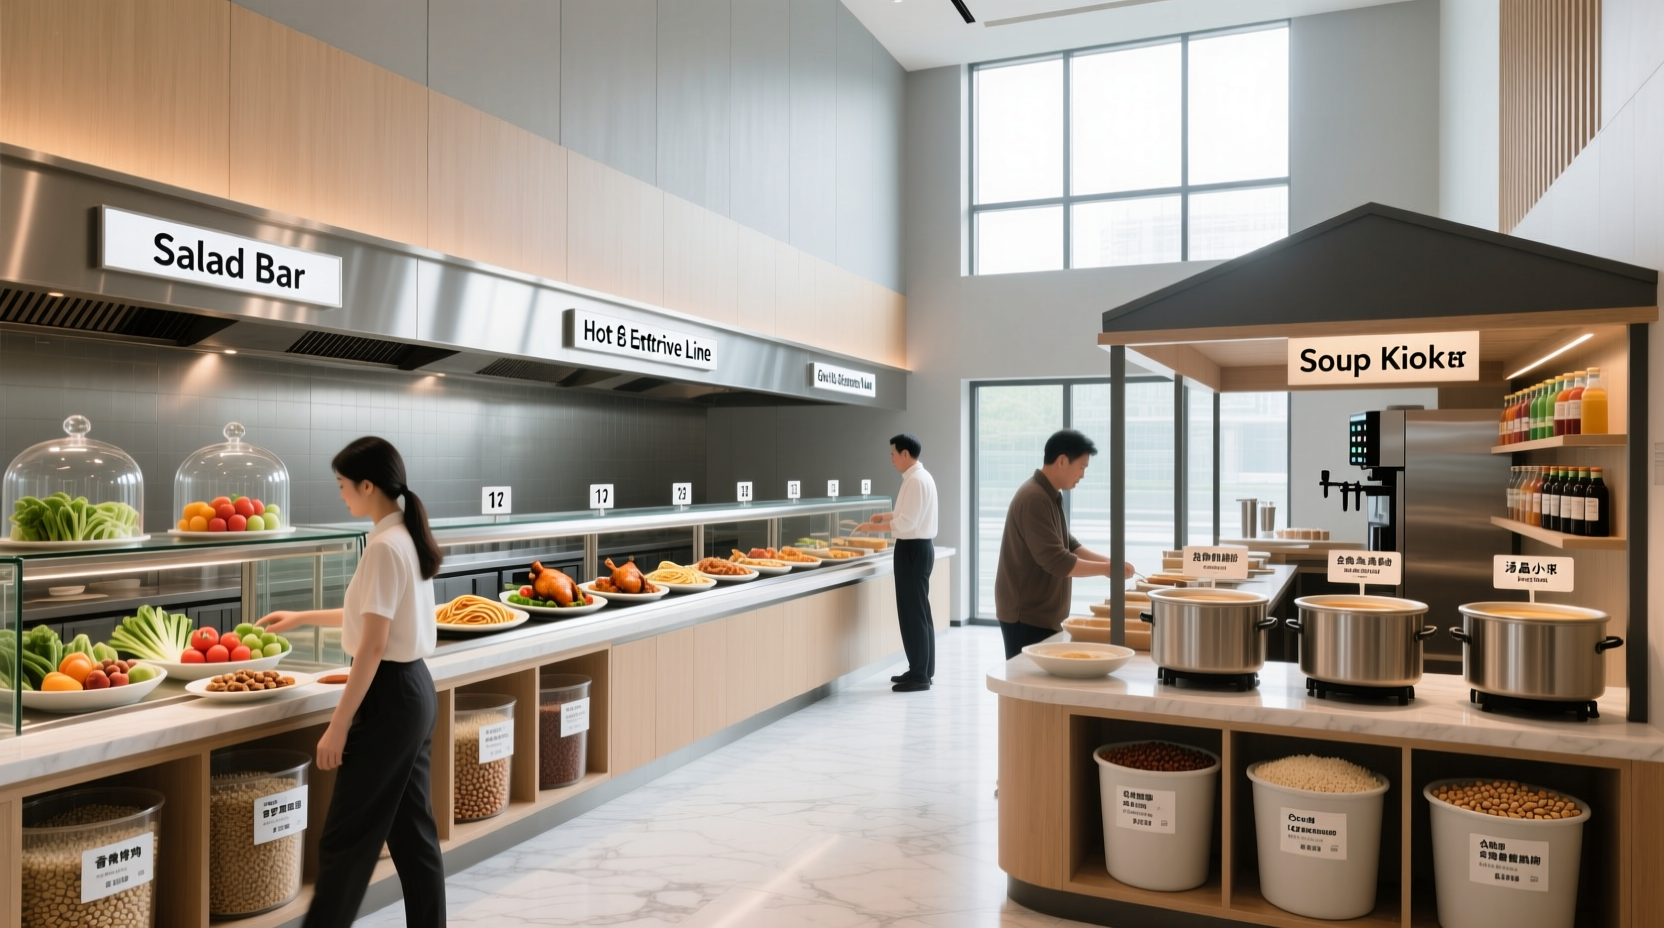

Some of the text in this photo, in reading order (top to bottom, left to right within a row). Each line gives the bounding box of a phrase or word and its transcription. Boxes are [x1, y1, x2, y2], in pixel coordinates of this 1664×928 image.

[153, 232, 306, 289] Salad Bar
[584, 319, 613, 344] Hot
[685, 339, 711, 361] Line
[1300, 348, 1371, 378] Soup
